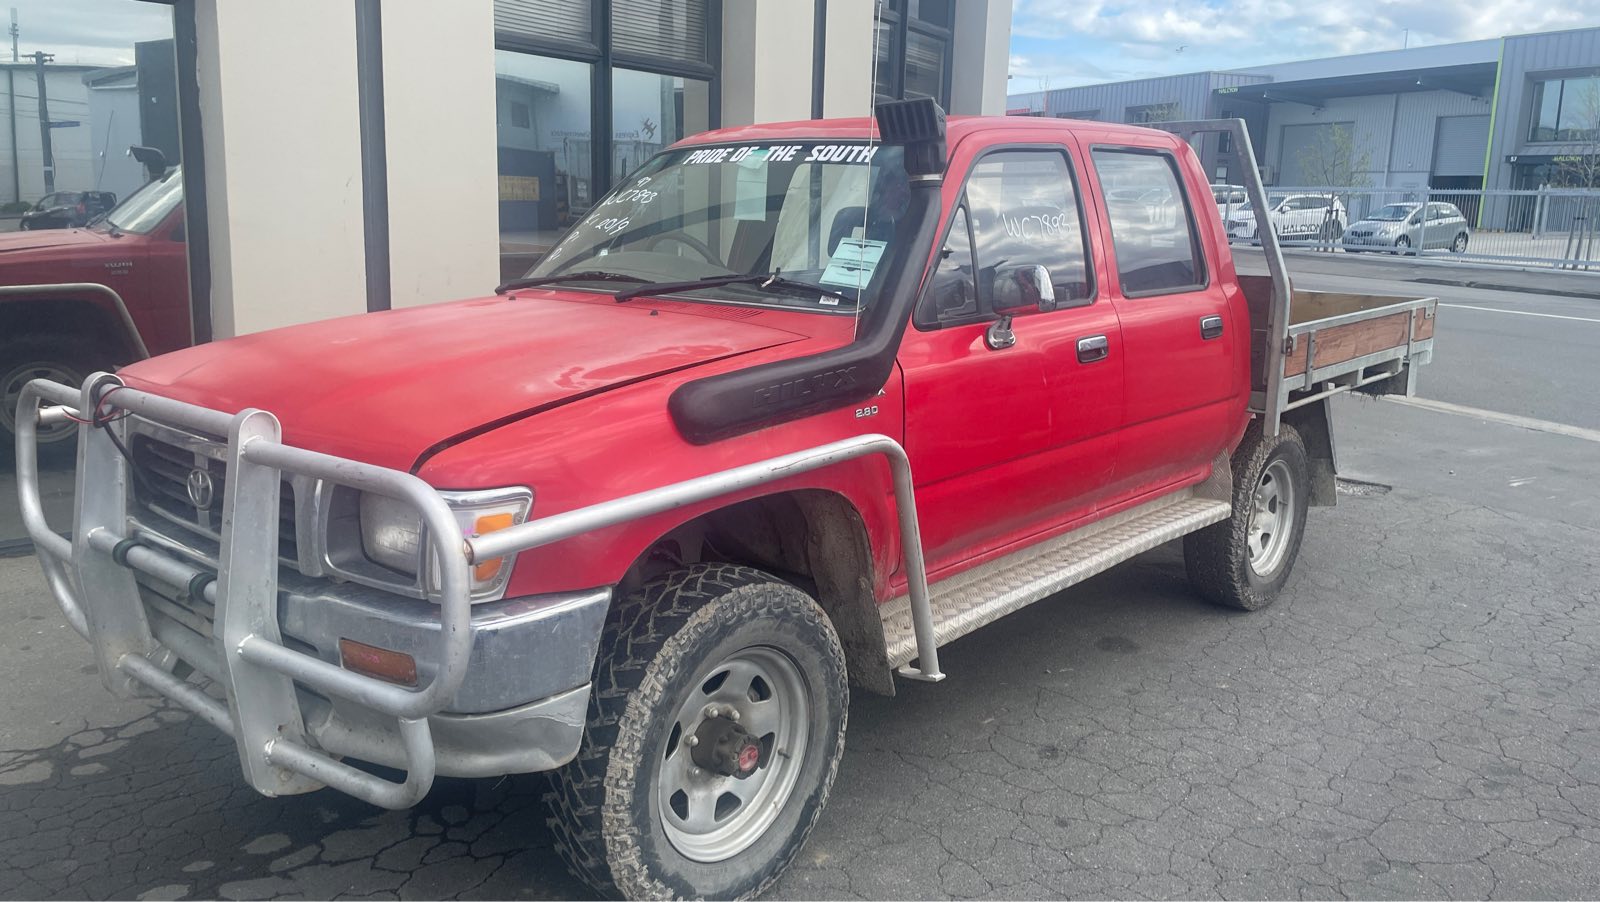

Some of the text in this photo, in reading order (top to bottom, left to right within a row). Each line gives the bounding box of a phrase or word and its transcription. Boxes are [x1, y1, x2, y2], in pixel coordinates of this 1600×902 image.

[683, 145, 879, 165] PRIDE OF THE SOUTH
[1002, 212, 1072, 239] WC7893
[752, 366, 858, 408] HILUX
